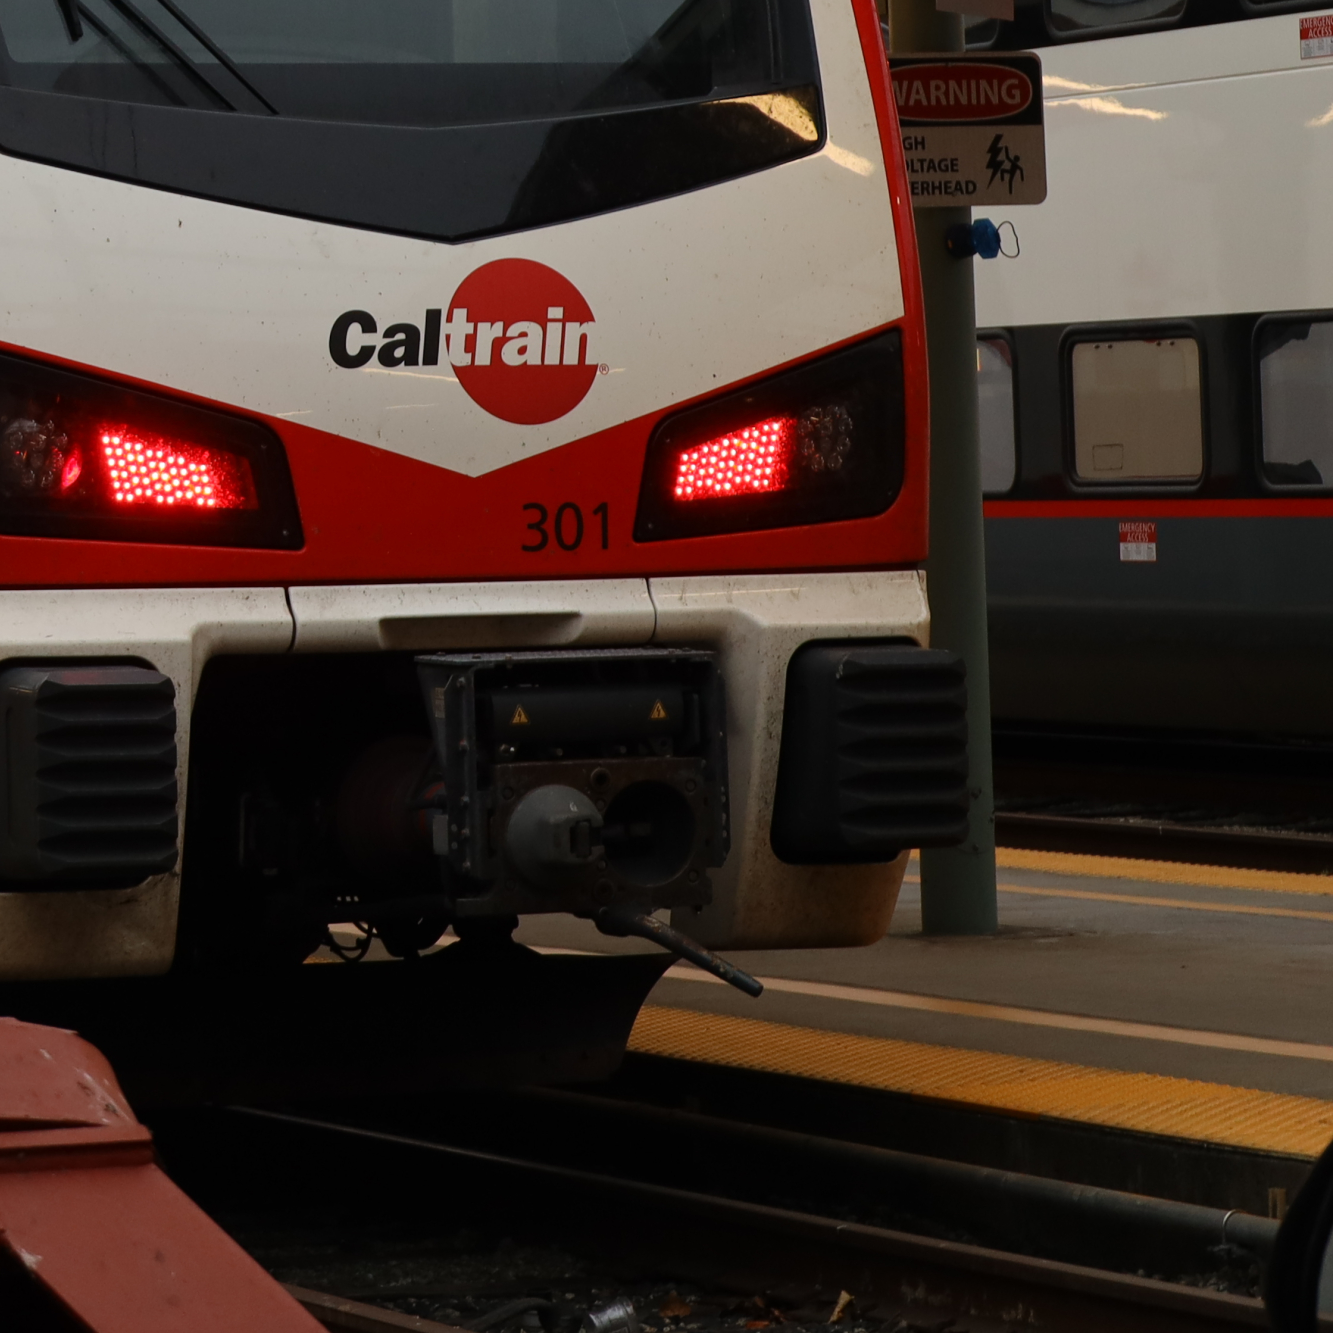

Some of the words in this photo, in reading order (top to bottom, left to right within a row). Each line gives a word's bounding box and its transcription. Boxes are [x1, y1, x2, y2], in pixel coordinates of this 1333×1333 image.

[1300, 16, 1333, 29] EMERGENC
[1308, 26, 1332, 38] ACCESS
[905, 157, 959, 174] LTAGE
[910, 180, 977, 196] ERHEAD
[329, 306, 599, 369] Caltrain
[521, 501, 609, 552] 301
